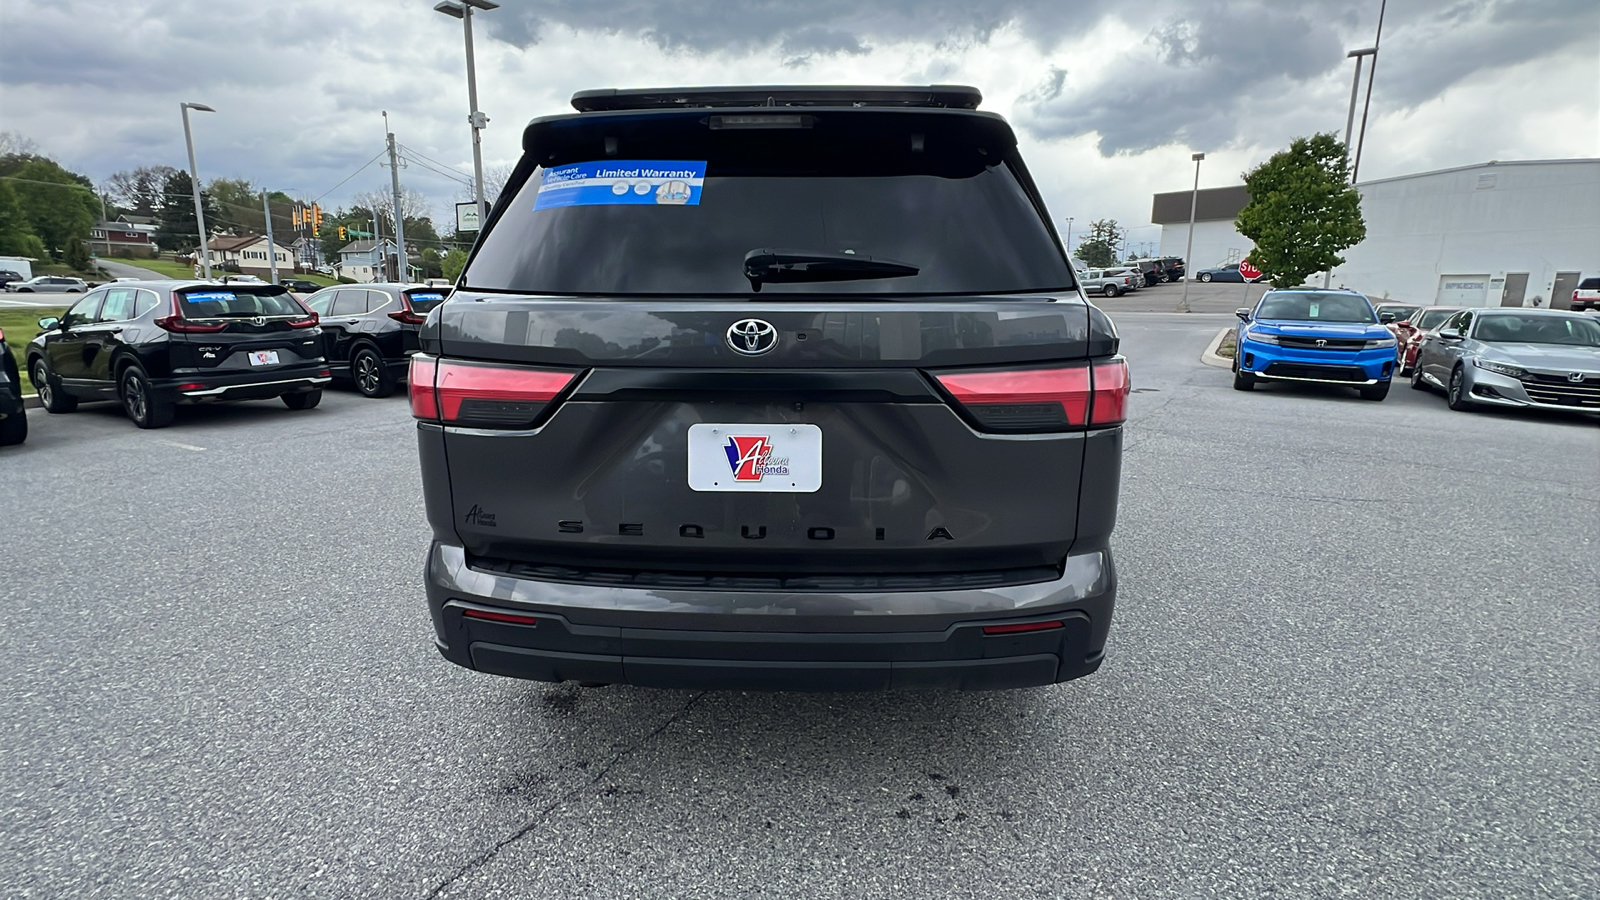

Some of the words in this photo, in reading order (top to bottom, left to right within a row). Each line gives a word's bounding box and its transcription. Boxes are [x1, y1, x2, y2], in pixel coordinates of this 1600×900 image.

[547, 173, 571, 184] Vehicle
[570, 172, 588, 180] Care
[549, 167, 579, 177] Assurant
[596, 168, 637, 178] Limited
[641, 168, 696, 180] Warranty
[757, 464, 788, 475] Honda
[558, 519, 955, 541] SEQUOIA
